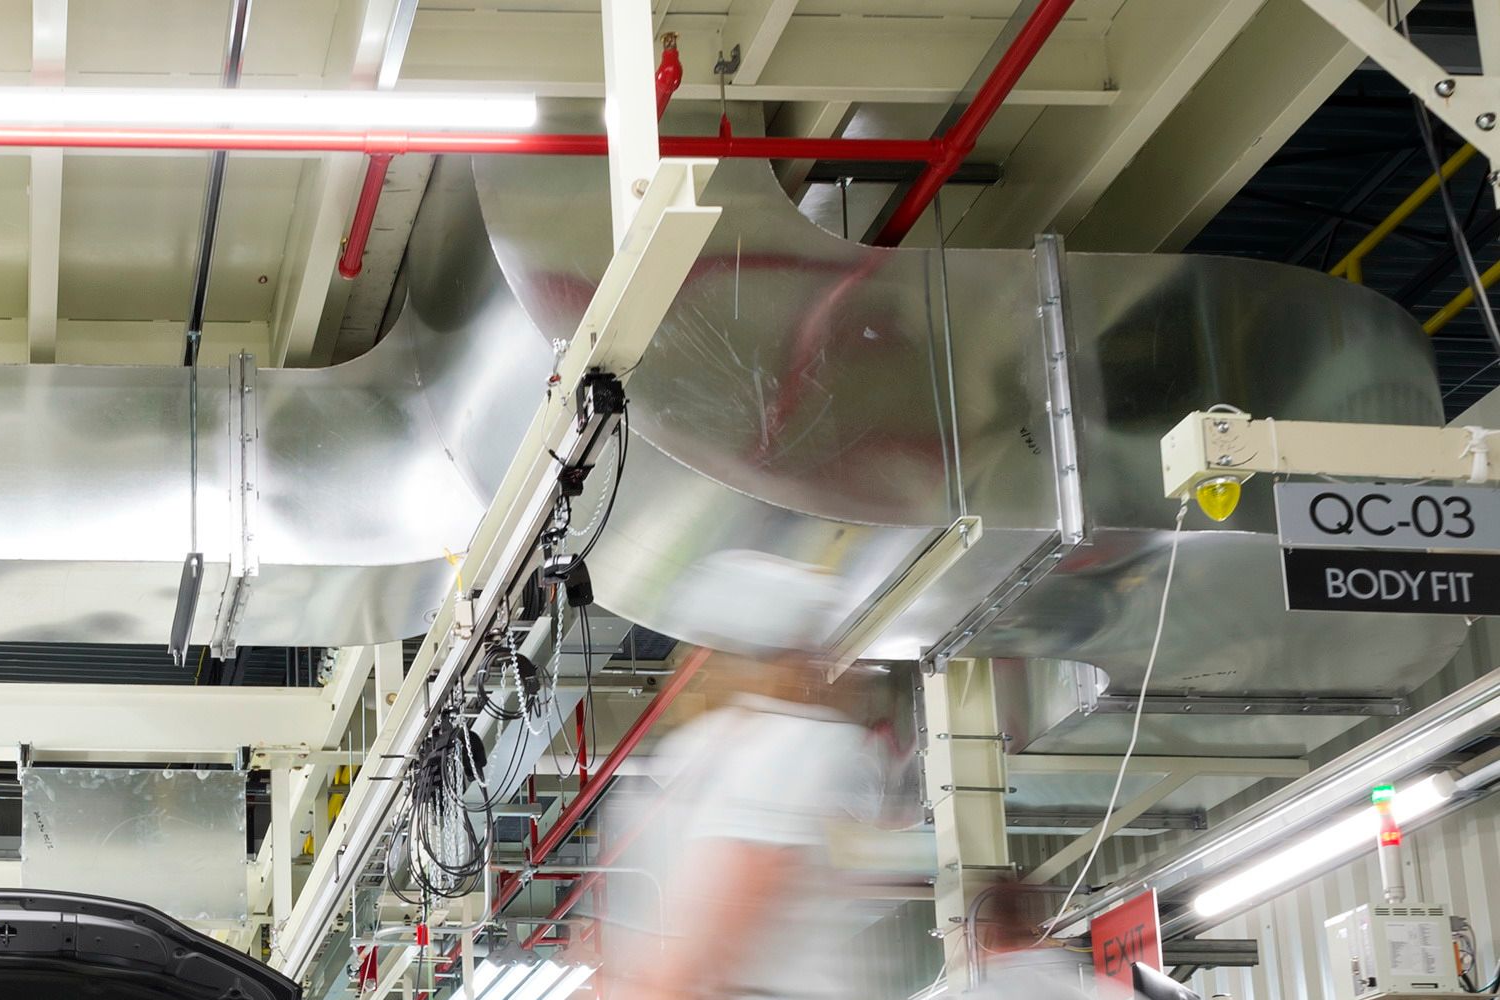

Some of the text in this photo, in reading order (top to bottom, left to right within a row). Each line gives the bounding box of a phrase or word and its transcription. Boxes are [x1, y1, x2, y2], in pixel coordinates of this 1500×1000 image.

[1309, 492, 1475, 538] QC-03
[1325, 568, 1474, 602] BODY FIT
[1103, 923, 1145, 977] EXIT
